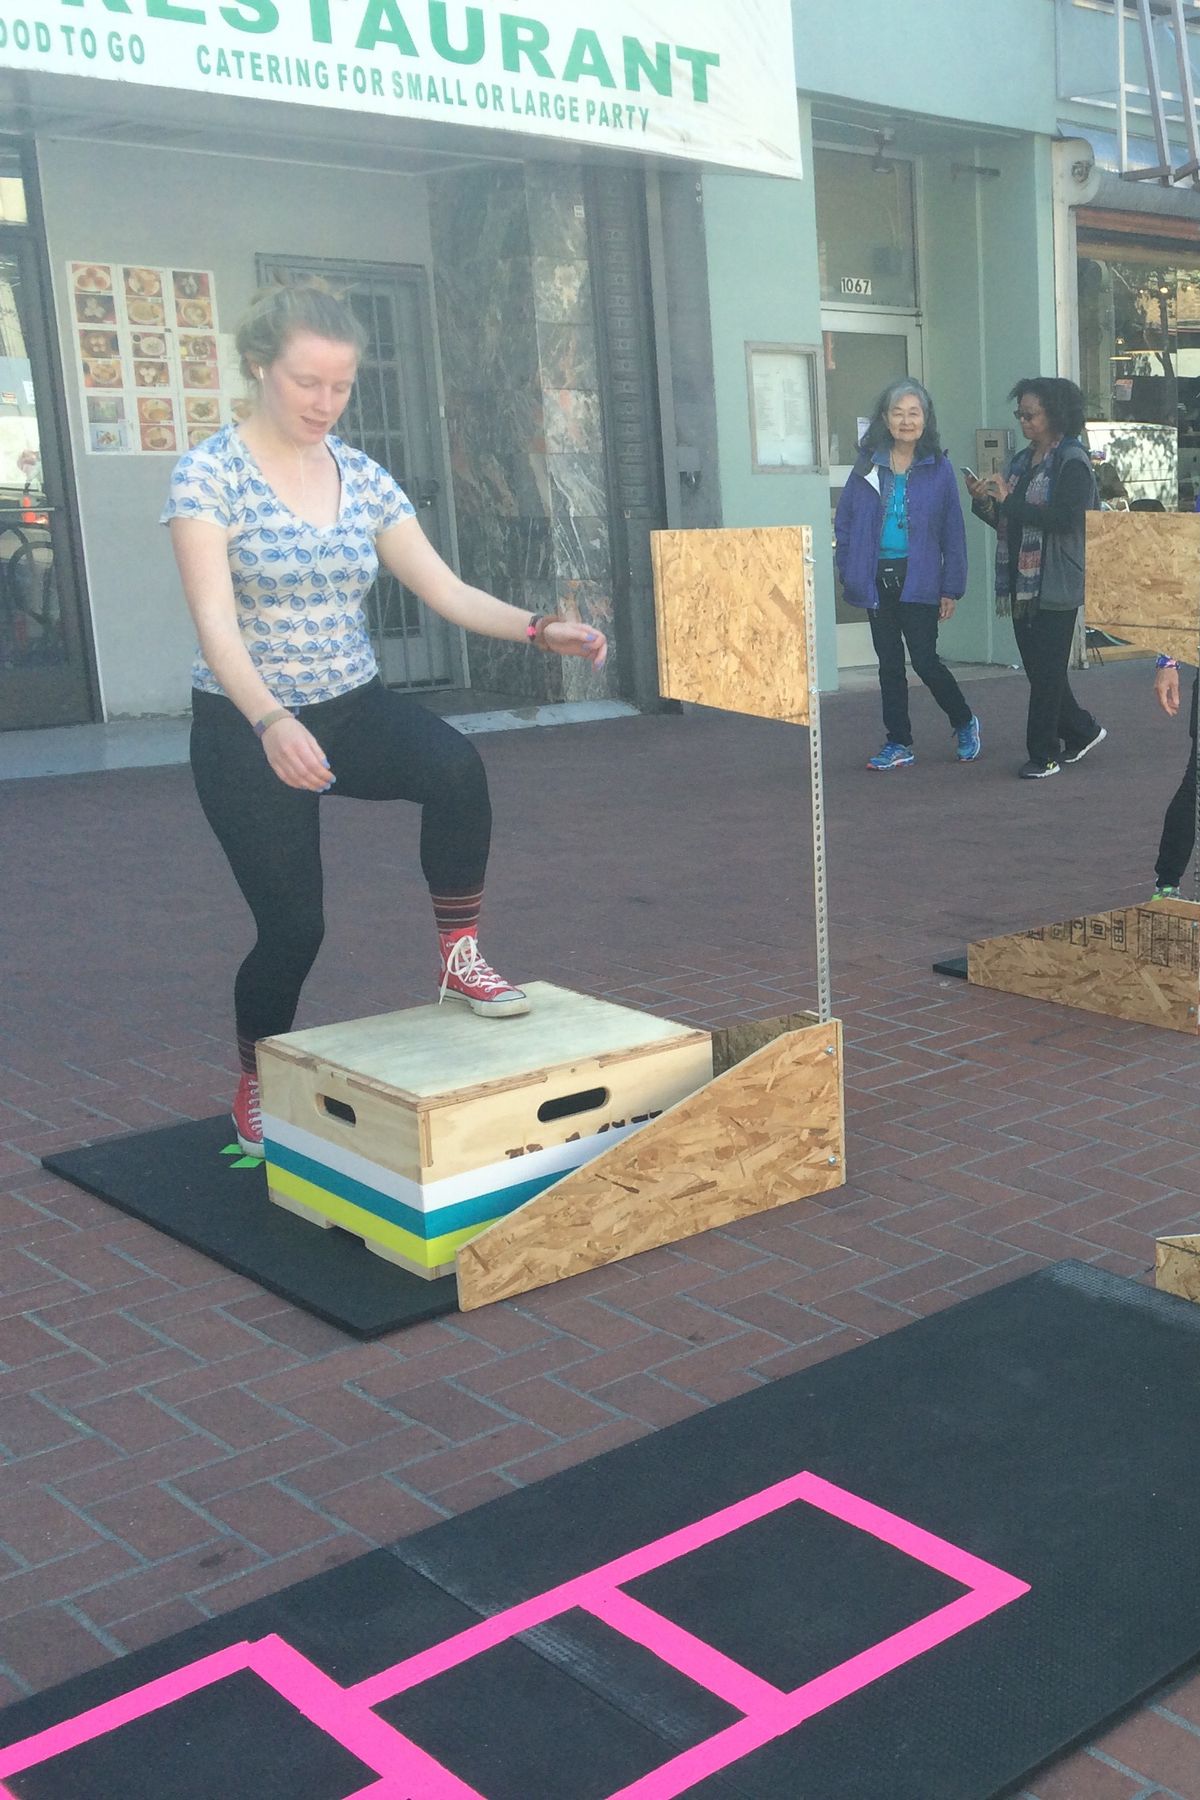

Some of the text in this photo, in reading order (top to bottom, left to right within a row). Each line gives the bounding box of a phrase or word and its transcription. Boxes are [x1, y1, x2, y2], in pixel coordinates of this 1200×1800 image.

[60, 25, 97, 59] TO
[107, 31, 146, 65] GO
[196, 44, 330, 90] CATERING
[338, 63, 385, 97] FOR
[392, 69, 468, 106] SMALL
[475, 81, 505, 112] OR
[510, 87, 580, 122] LARGE
[586, 99, 650, 131] PARTY
[841, 278, 870, 294] 1067
